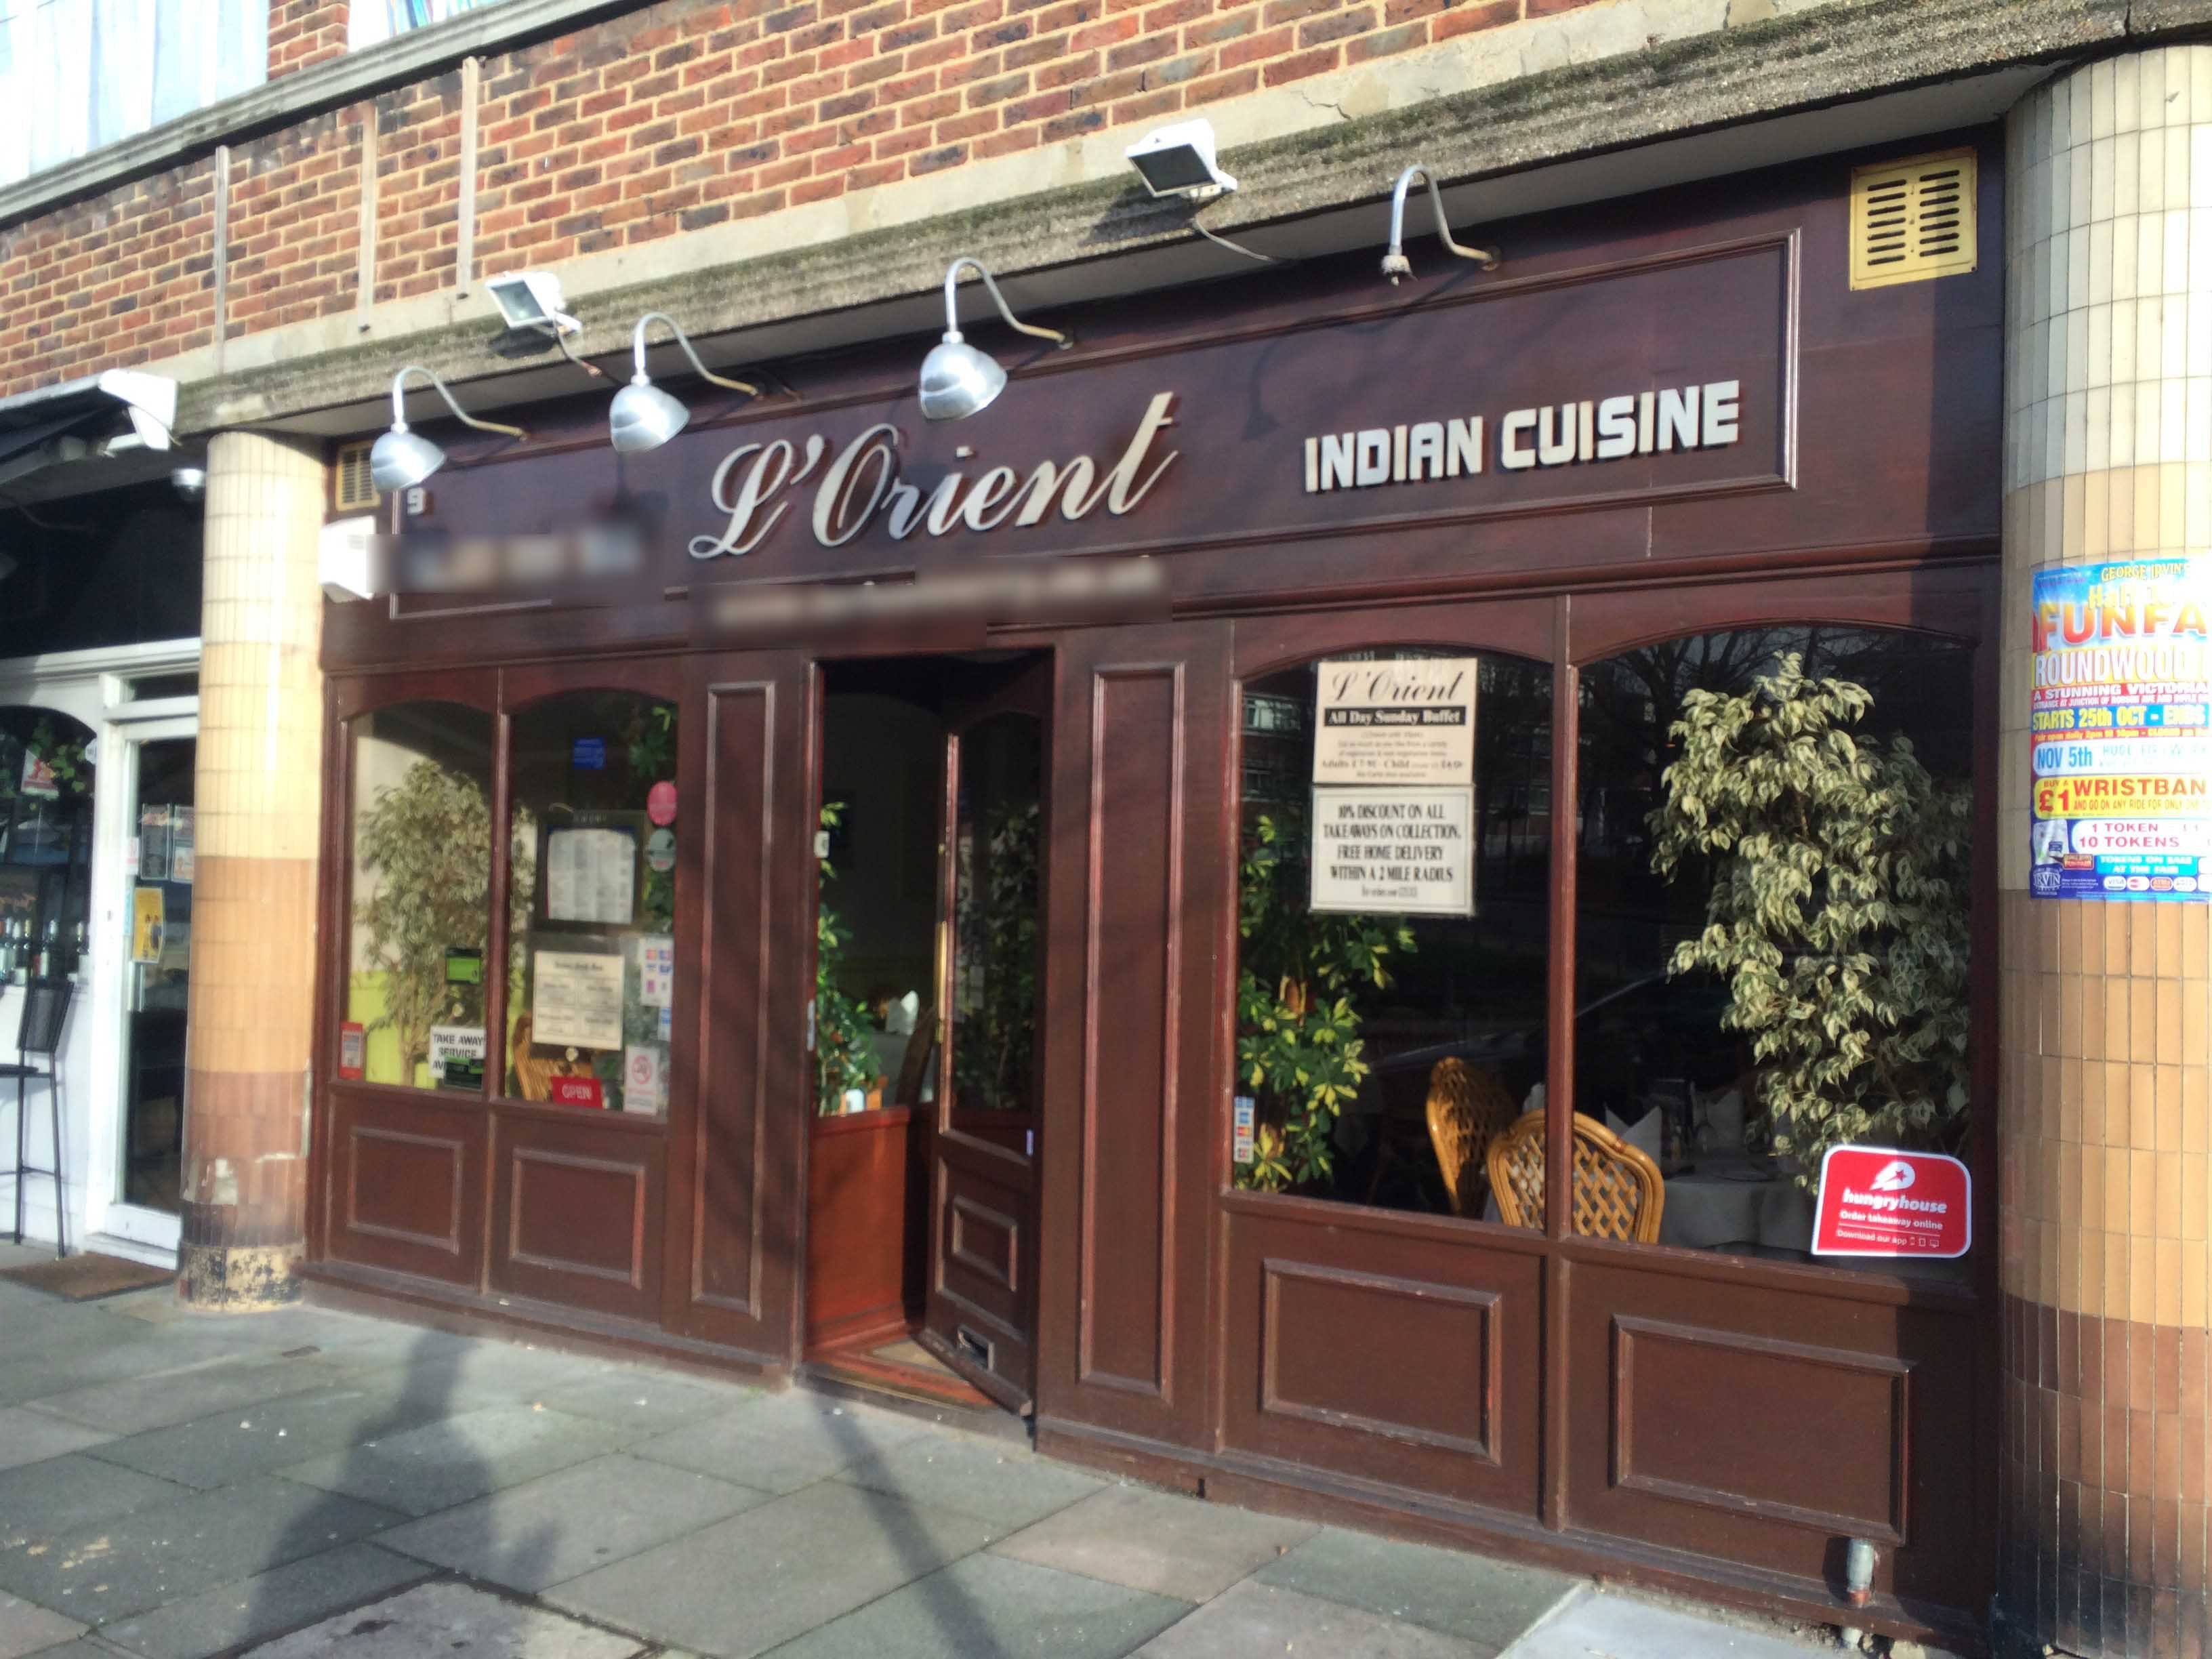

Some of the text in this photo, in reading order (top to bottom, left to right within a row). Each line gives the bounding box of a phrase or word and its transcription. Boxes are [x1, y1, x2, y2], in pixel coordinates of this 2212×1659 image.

[1305, 380, 1740, 493] INDIAN CUISINE
[688, 392, 1179, 560] L'Orient
[2102, 565, 2147, 581] GEORGE
[2039, 600, 2209, 651] FUNFA
[2035, 646, 2188, 687] ROUNDWOOD
[1332, 671, 1464, 701] L'Orient
[2034, 682, 2210, 701] A STUNNING VICTORIA
[2070, 697, 2100, 706] JUNCTION
[1328, 710, 1460, 726] All Day Sunday Buffet
[2033, 709, 2074, 731] STARTS
[2078, 707, 2112, 727] 25th
[2116, 705, 2147, 726] OCT
[2037, 747, 2063, 769] NOV
[2068, 745, 2093, 767] 5th
[2073, 778, 2207, 796] WRISTBAN
[2039, 789, 2070, 813] £1
[2074, 800, 2087, 811] AND
[2089, 800, 2098, 810] GO
[2100, 800, 2110, 810] ON
[2112, 799, 2127, 810] ANY
[2129, 799, 2146, 809] RIDE
[2148, 798, 2162, 810] FOR
[2165, 798, 2183, 810] ONLY
[1357, 804, 1405, 819] DISCOUNT
[1408, 804, 1422, 819] ON
[1427, 804, 1446, 819] ALL
[1380, 824, 1393, 839] ON
[2104, 823, 2158, 832] TOKEN
[2079, 836, 2180, 848] 10 TOKENS
[1337, 844, 1444, 860] FREE HOME DELIVERY
[1330, 865, 1454, 882] WITHIN A 2 MILE RADIUS
[2034, 872, 2061, 886] IRVIN
[433, 1033, 485, 1046] TAKE AWAY
[438, 1047, 477, 1059] SERVICE
[561, 1084, 592, 1100] OPEN
[1842, 1188, 1948, 1214] hungryhouse
[1839, 1209, 1944, 1231] Order takeaway online
[1836, 1229, 1876, 1242] Download
[1892, 1236, 1907, 1246] app
